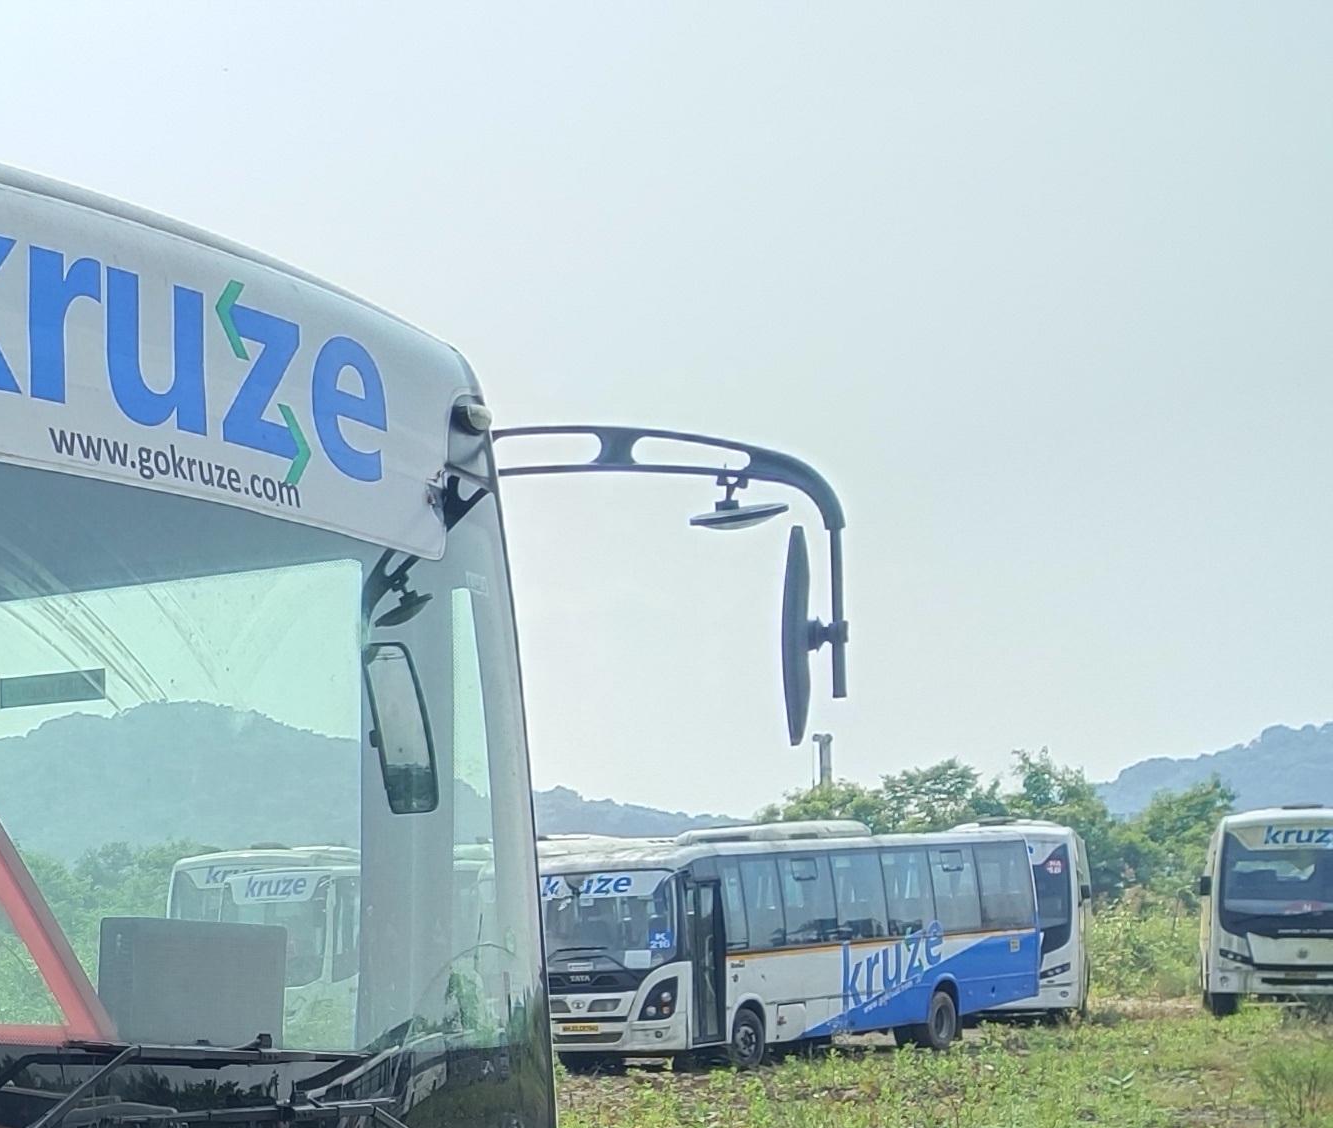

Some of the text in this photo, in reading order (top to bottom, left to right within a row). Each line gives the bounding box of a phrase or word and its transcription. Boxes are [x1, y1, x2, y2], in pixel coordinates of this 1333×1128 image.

[48, 426, 301, 509] www.gokruze.com
[245, 876, 307, 898] kruze
[569, 975, 590, 983] TATA
[842, 920, 944, 1013] kruze
